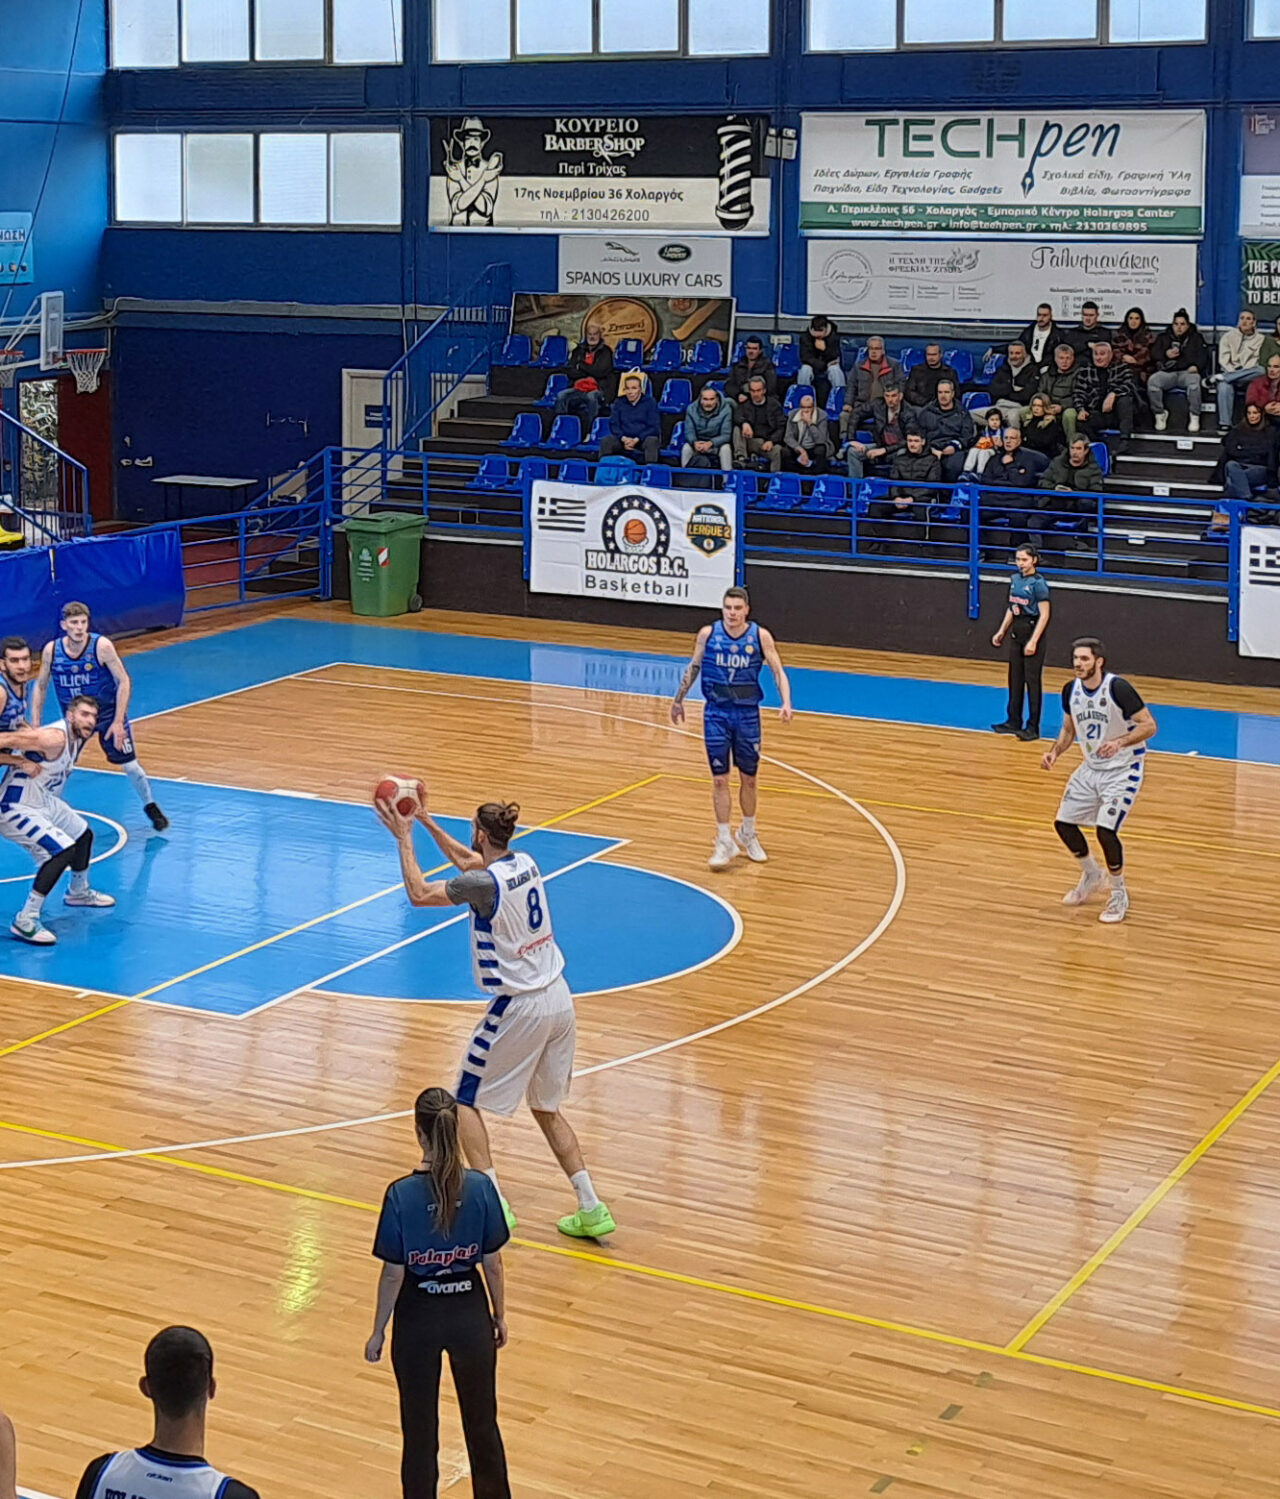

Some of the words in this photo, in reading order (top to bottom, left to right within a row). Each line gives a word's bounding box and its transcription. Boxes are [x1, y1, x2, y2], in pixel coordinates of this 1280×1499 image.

[554, 118, 639, 133] ΚΟΥΡΕΙΟ
[558, 162, 585, 176] Περί
[587, 162, 627, 177] Τρίχας
[514, 187, 541, 201] 17ης
[543, 187, 605, 200] Νοεμβρίου
[608, 188, 623, 199] 36
[625, 188, 684, 203] Χολαργός
[959, 186, 1004, 195] Gadgets
[571, 208, 650, 222] 2130426200
[1041, 206, 1081, 218] Κέντρο
[1248, 260, 1269, 273] THE
[565, 271, 621, 286] SPANOS
[624, 272, 681, 287] LUXURY
[684, 273, 723, 288] CARS
[1247, 275, 1269, 289] YOU
[1247, 290, 1261, 304] TO
[586, 551, 658, 574] HOLARGOS
[660, 556, 688, 577] B.C.
[585, 574, 688, 598] Basketball
[716, 654, 750, 668] ILION
[727, 669, 736, 682] 7
[1086, 724, 1102, 740] 21
[526, 886, 543, 931] 8
[425, 1280, 473, 1294] avance
